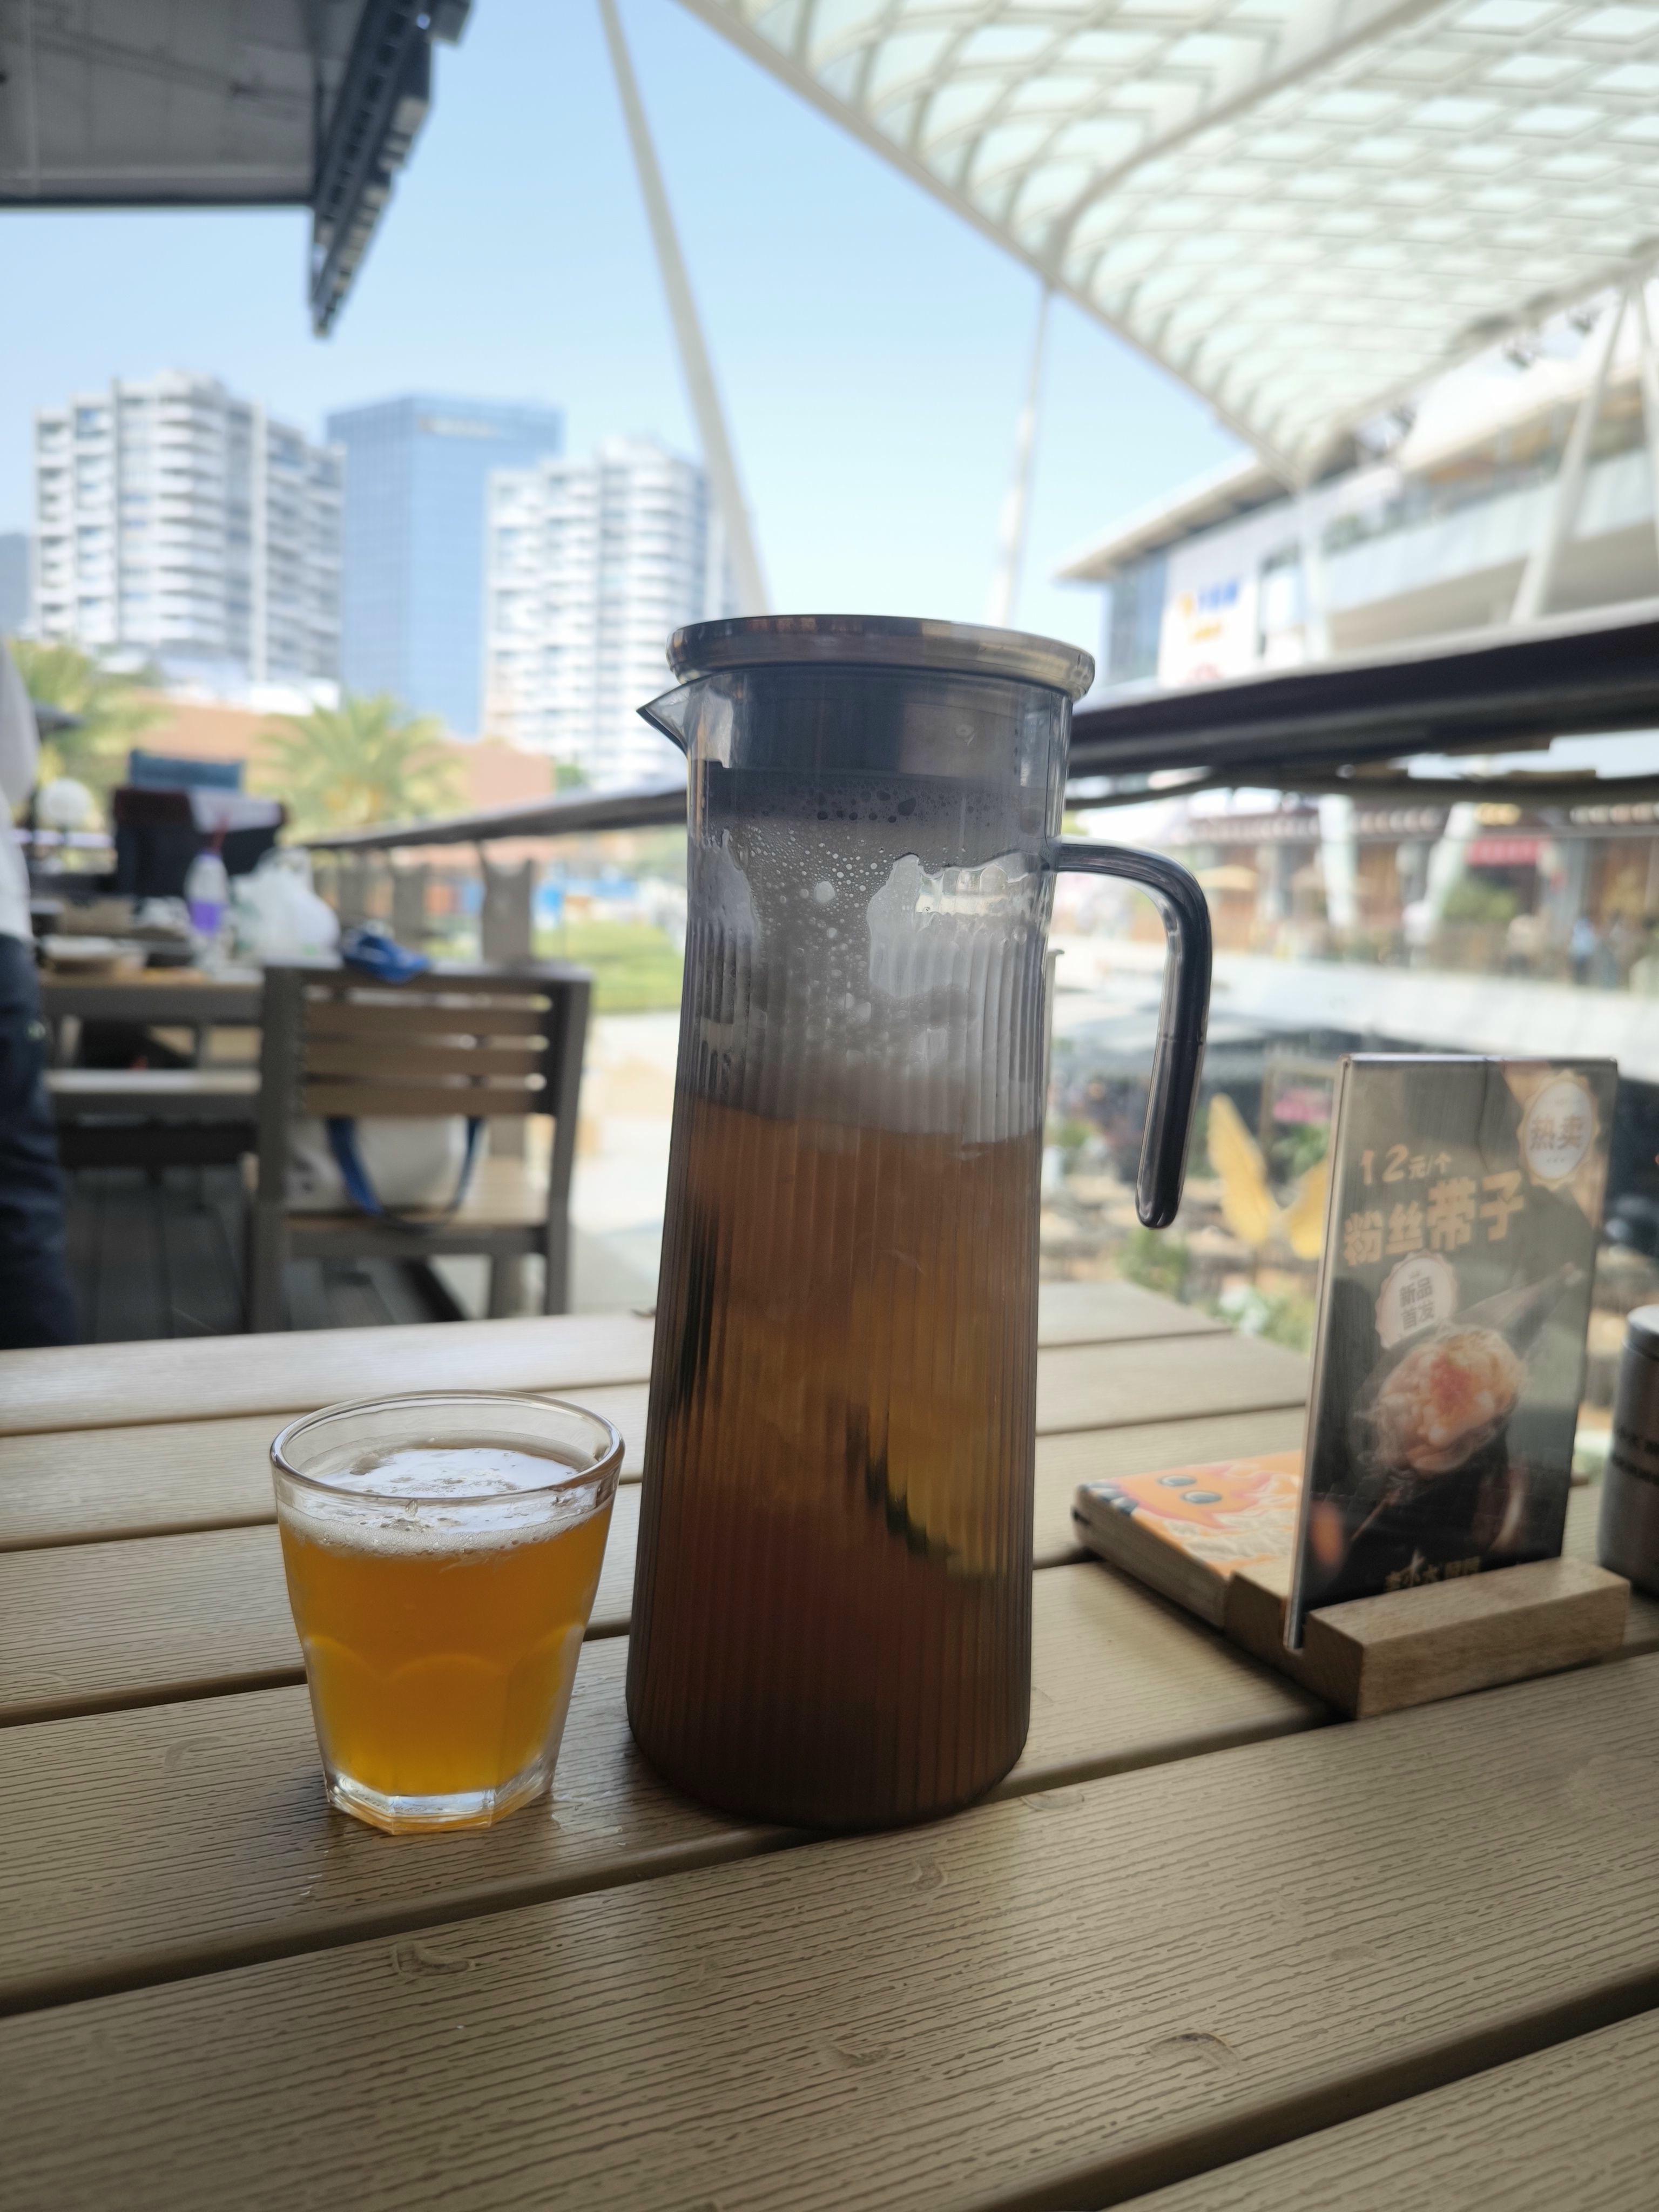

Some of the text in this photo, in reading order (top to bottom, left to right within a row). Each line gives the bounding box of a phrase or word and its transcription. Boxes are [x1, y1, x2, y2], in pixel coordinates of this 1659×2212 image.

[1344, 1170, 1525, 1267] 粉丝带子
[1400, 1277, 1433, 1307] 新品
[1401, 1299, 1435, 1330] 首发
